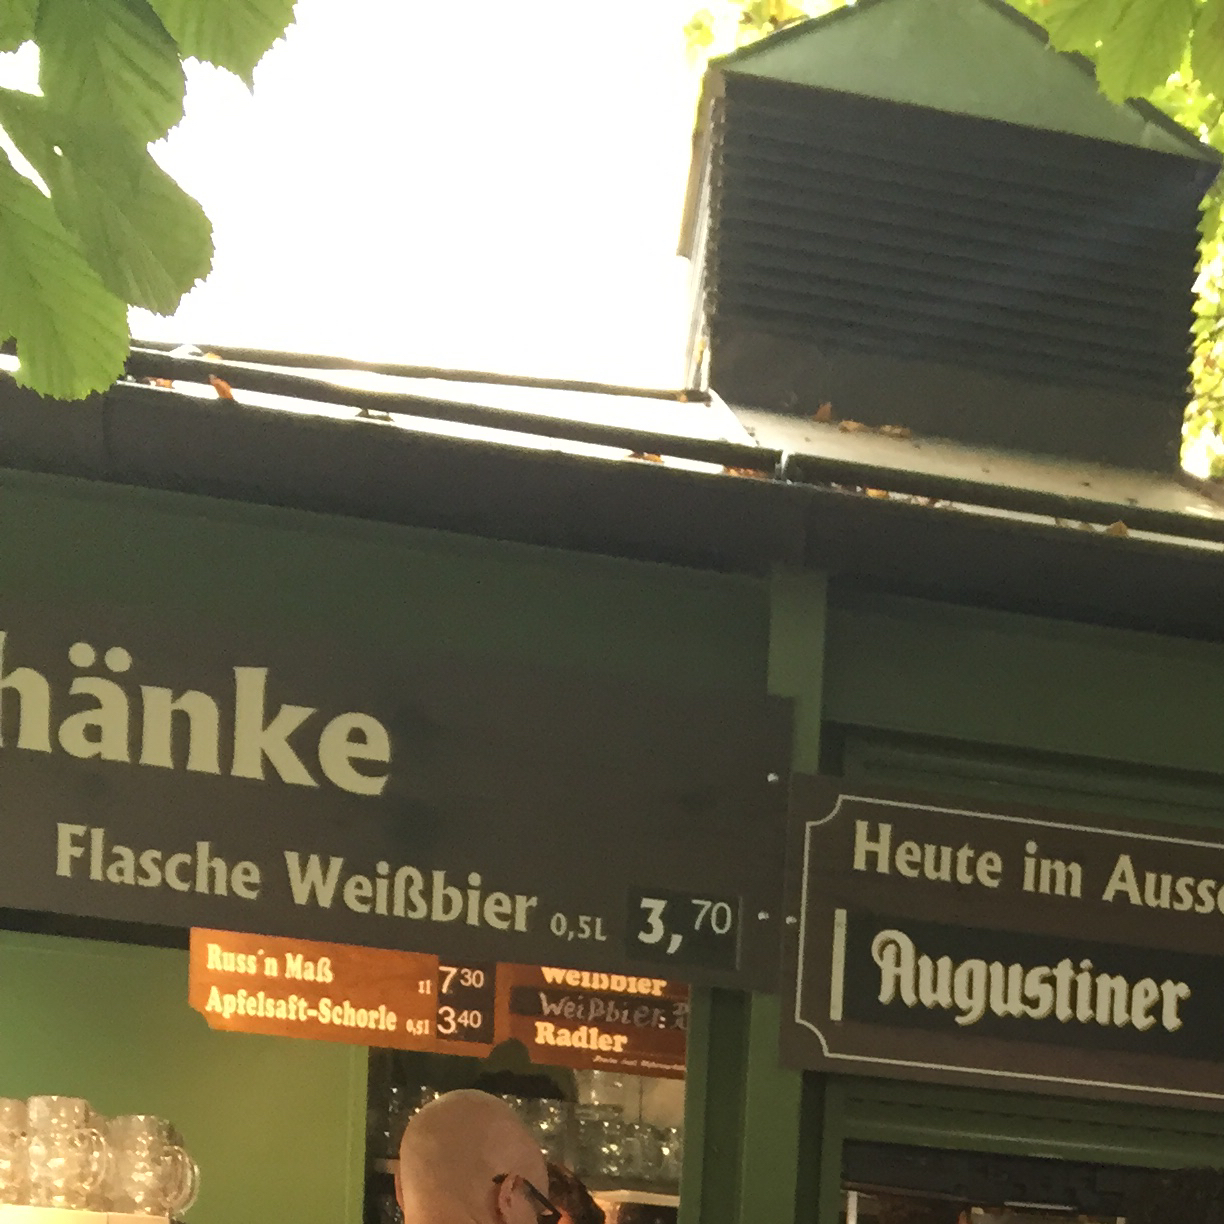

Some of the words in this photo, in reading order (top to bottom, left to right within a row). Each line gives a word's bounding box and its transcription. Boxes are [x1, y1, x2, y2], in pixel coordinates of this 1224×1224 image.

[55, 822, 263, 900] Flasche
[284, 850, 538, 932] Weißbier
[550, 911, 608, 942] 0,5L
[637, 896, 733, 955] 3,70
[853, 819, 1003, 889] Heute
[1022, 838, 1083, 899] im
[284, 951, 334, 984] Maß
[871, 929, 1191, 1033] Augustiner
[204, 985, 398, 1032] Apfelsaft-Schorle
[534, 1021, 629, 1052] Radler
